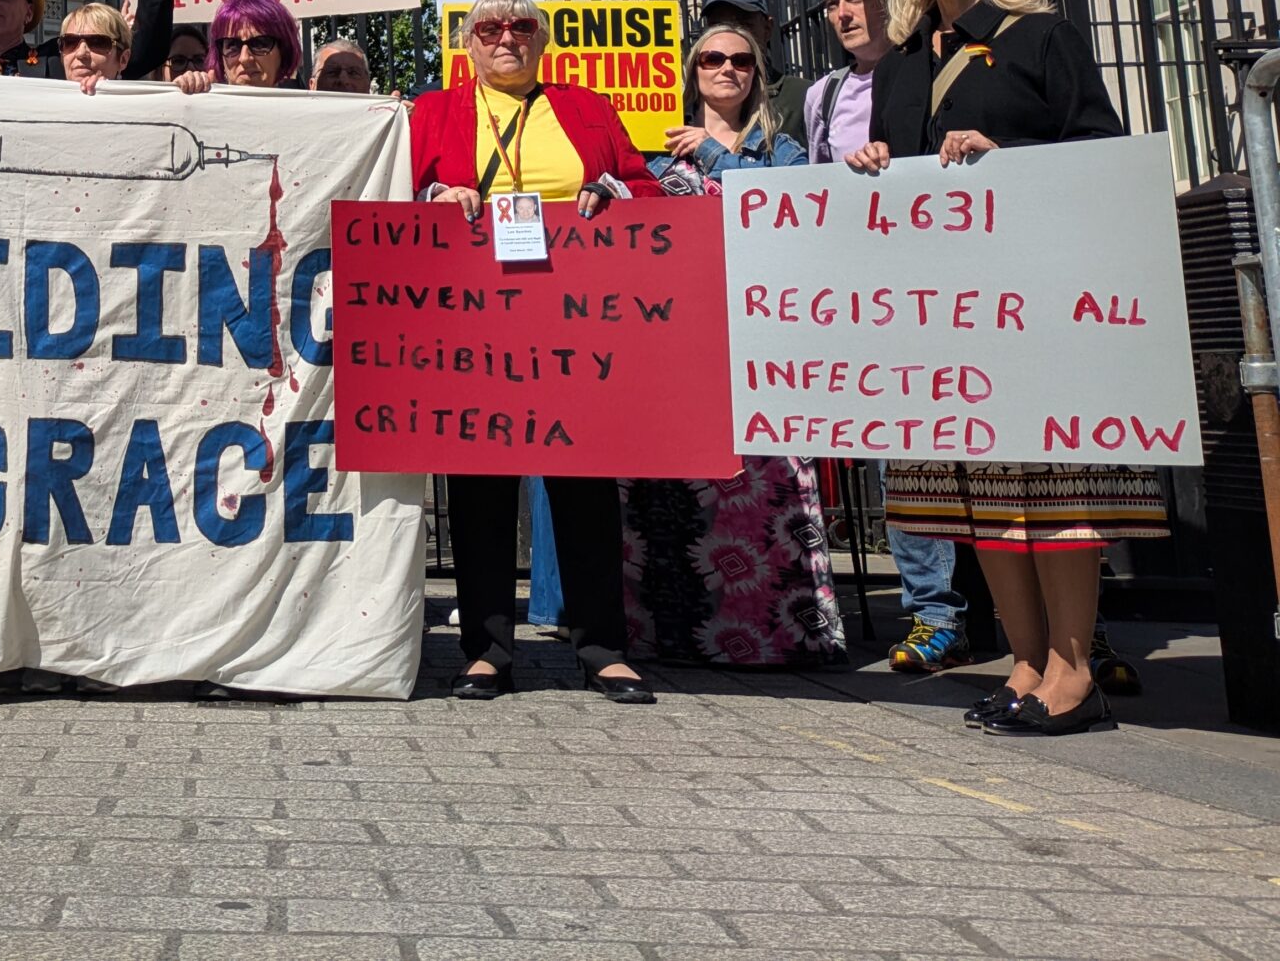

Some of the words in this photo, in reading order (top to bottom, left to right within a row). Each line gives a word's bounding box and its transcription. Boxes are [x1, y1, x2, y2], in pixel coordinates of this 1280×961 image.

[542, 51, 677, 89] ICTIMS
[612, 92, 677, 112] BLOOD
[740, 188, 829, 229] PAY
[867, 188, 994, 236] 4631
[346, 281, 523, 312] INVENT
[563, 292, 674, 323] NEW
[745, 285, 1025, 332] REGISTER
[1072, 291, 1147, 327] ALL
[746, 359, 993, 404] INFECTED
[744, 411, 996, 456] AFFECTED
[1043, 415, 1187, 454] NOW
